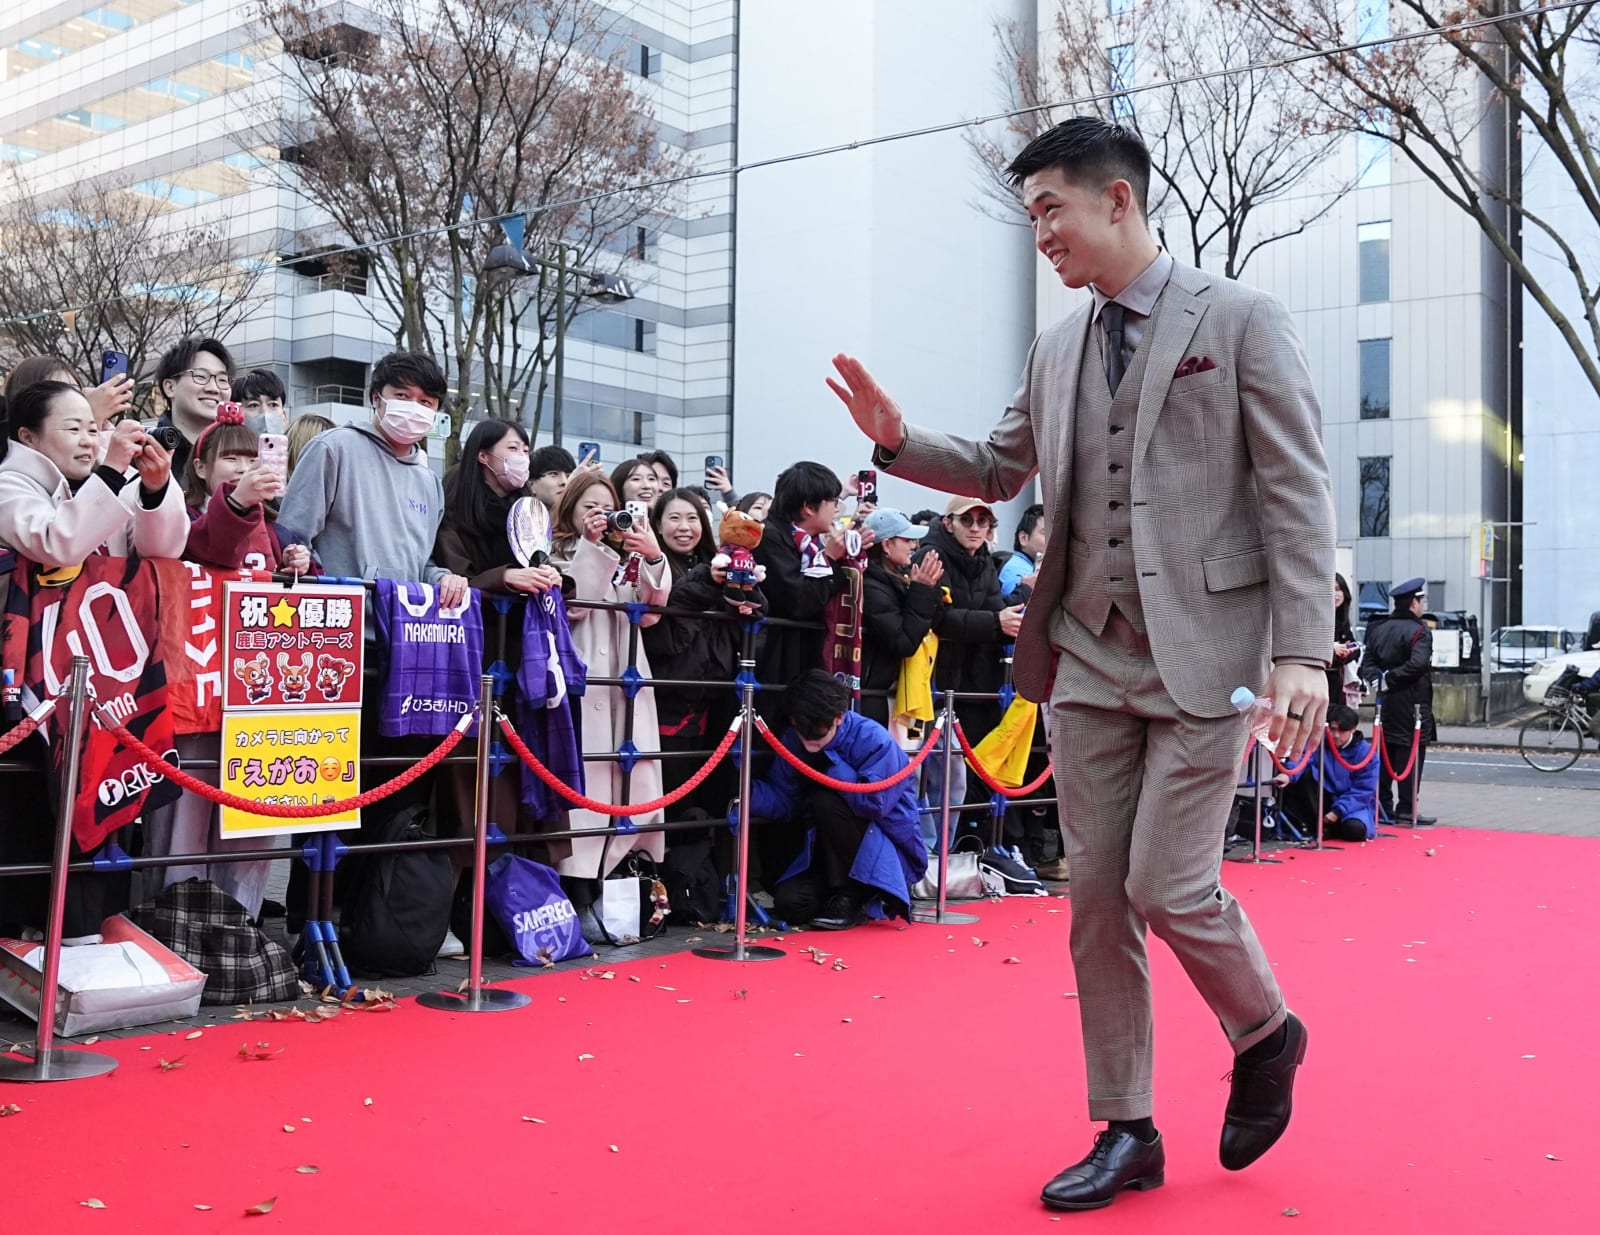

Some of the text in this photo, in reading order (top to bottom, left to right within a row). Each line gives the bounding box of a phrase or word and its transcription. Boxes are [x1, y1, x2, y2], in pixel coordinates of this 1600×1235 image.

[42, 581, 150, 697] 40
[236, 631, 353, 649] 鹿島アントラーズ
[404, 622, 466, 644] NAKAMURA
[236, 728, 349, 747] カメラに向かって
